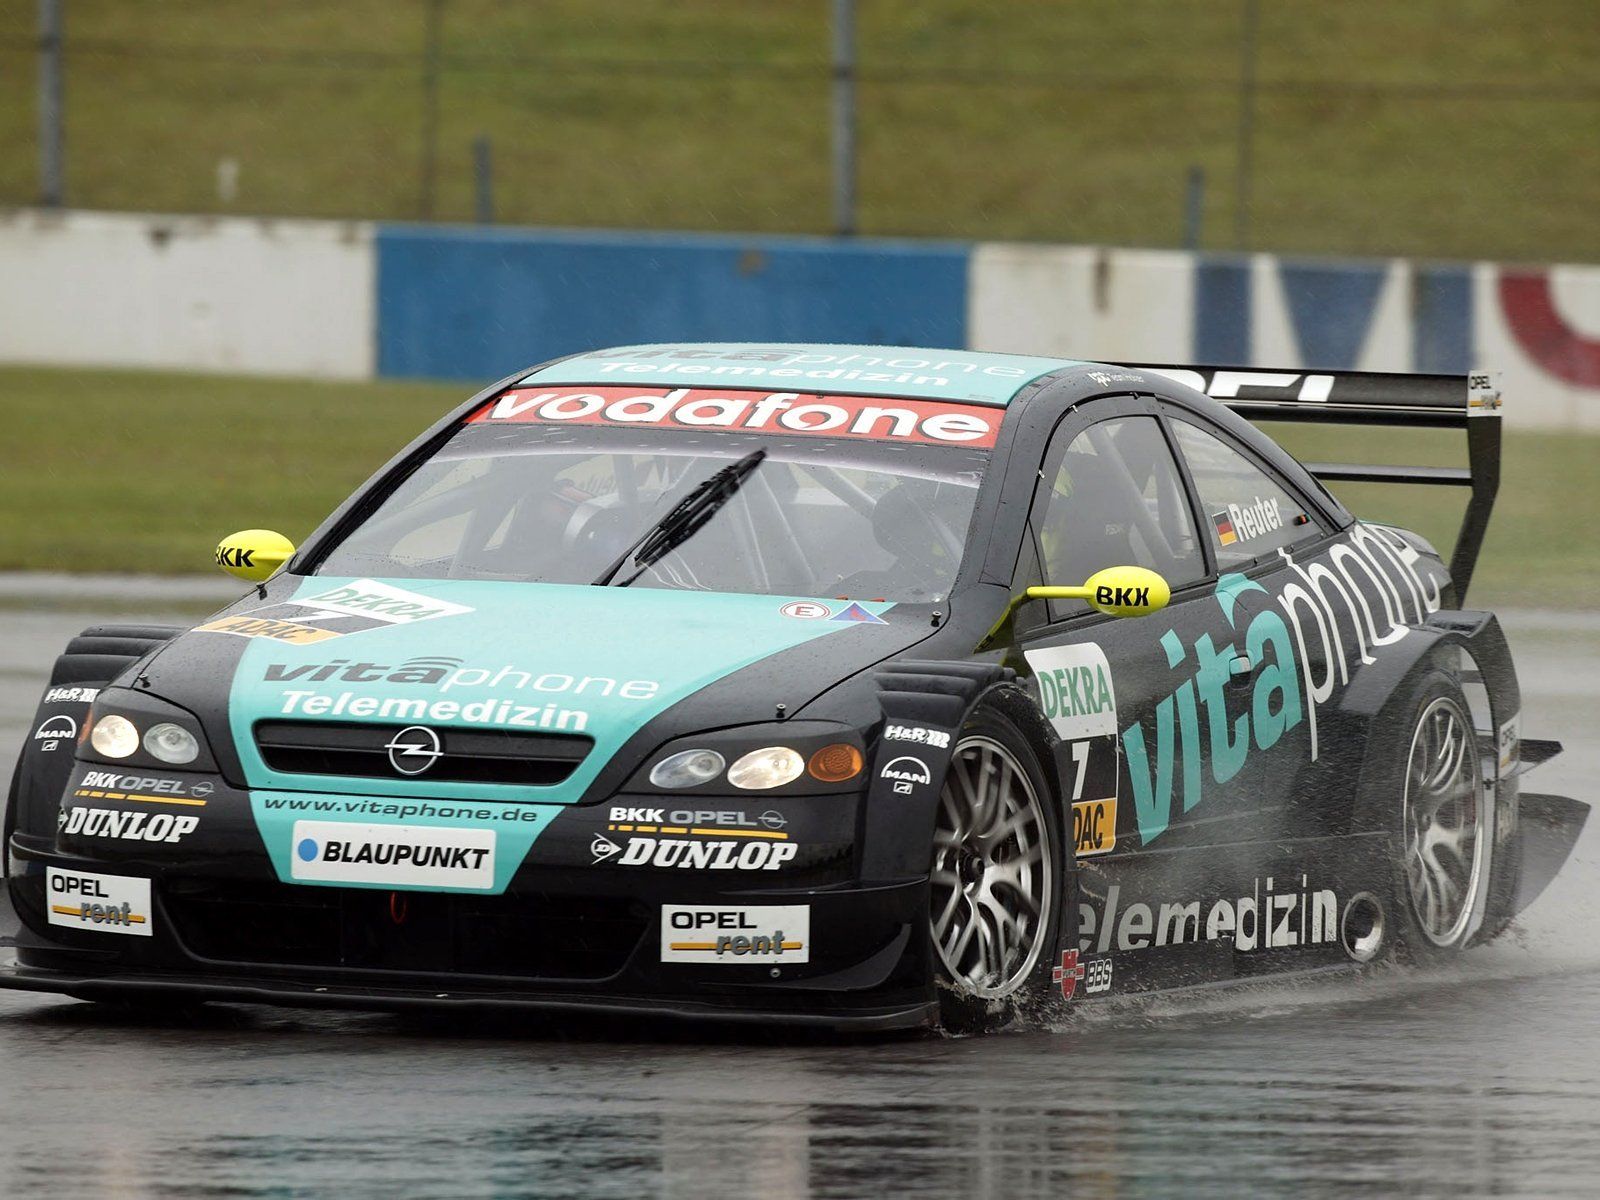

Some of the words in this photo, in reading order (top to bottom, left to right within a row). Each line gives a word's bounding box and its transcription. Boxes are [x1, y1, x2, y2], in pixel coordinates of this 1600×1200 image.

[583, 348, 1026, 378] vitaphone
[600, 362, 949, 387] Telemedizin
[491, 388, 990, 441] vodafone
[1228, 496, 1284, 542] Reuter
[309, 588, 445, 618] DEKRA
[218, 620, 316, 639] ADAC
[263, 656, 660, 702] vitaphone
[1037, 663, 1114, 720] DEKRA
[1122, 523, 1440, 846] vitaphone
[44, 688, 82, 703] H&R
[281, 690, 589, 733] Telemedizin
[38, 730, 73, 738] MAN
[884, 725, 929, 743] H&R
[80, 771, 122, 789] BKK
[118, 776, 187, 795] OPEL
[885, 770, 926, 784] MAN
[1072, 741, 1090, 800] 7
[264, 799, 537, 822] www.vitaphone.de
[609, 807, 665, 823] BKK
[669, 810, 758, 826] OPEL
[64, 806, 200, 843] DUNLOP
[322, 841, 489, 870] BLAUPUNKT
[617, 837, 799, 871] DUNLOP
[52, 874, 109, 898] OPEL
[80, 901, 131, 926] rent
[671, 911, 758, 929] OPEL
[716, 930, 786, 956] rent
